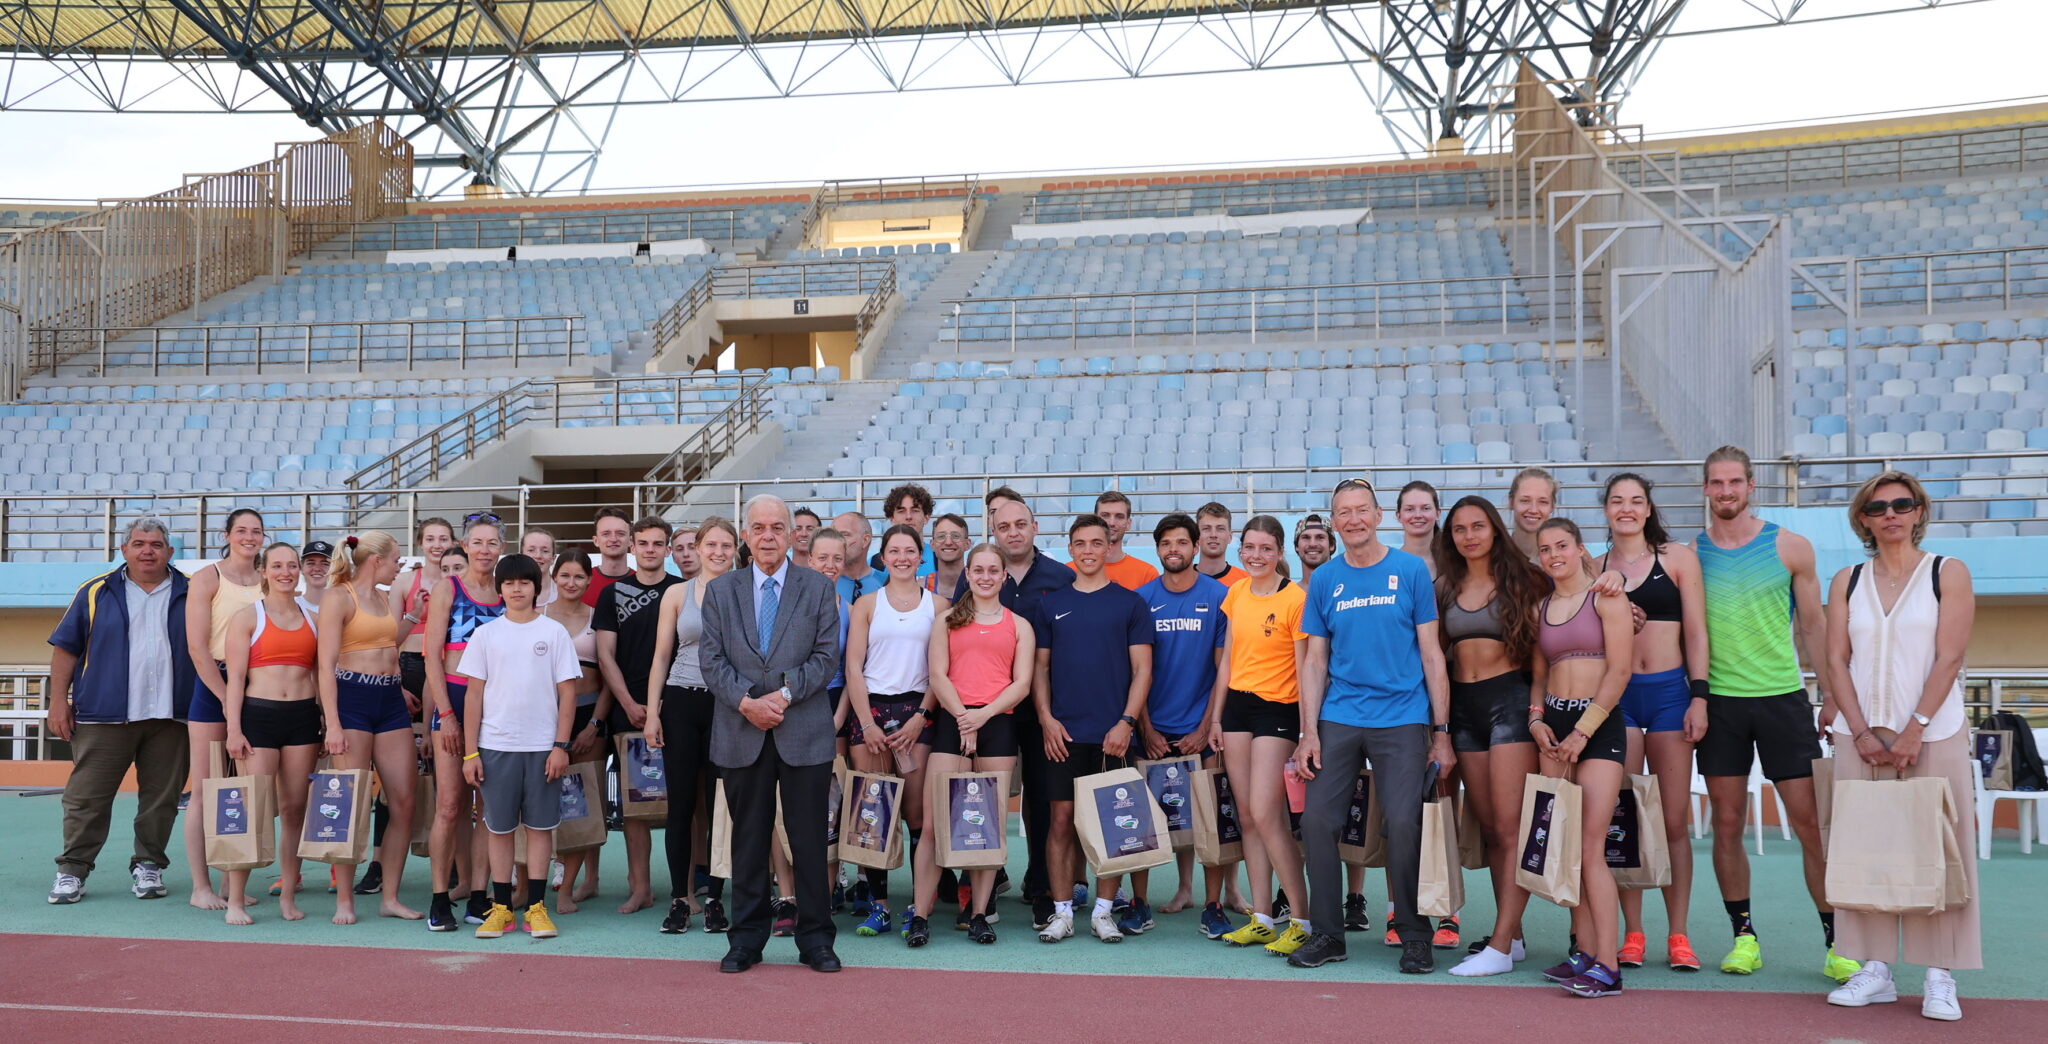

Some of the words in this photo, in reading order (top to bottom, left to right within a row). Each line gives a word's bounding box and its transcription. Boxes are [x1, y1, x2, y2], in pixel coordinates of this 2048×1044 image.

[797, 303, 807, 311] 11
[617, 589, 659, 624] didas
[1156, 618, 1202, 632] ESTONIA
[358, 673, 391, 687] NIKE
[1567, 697, 1595, 712] PR
